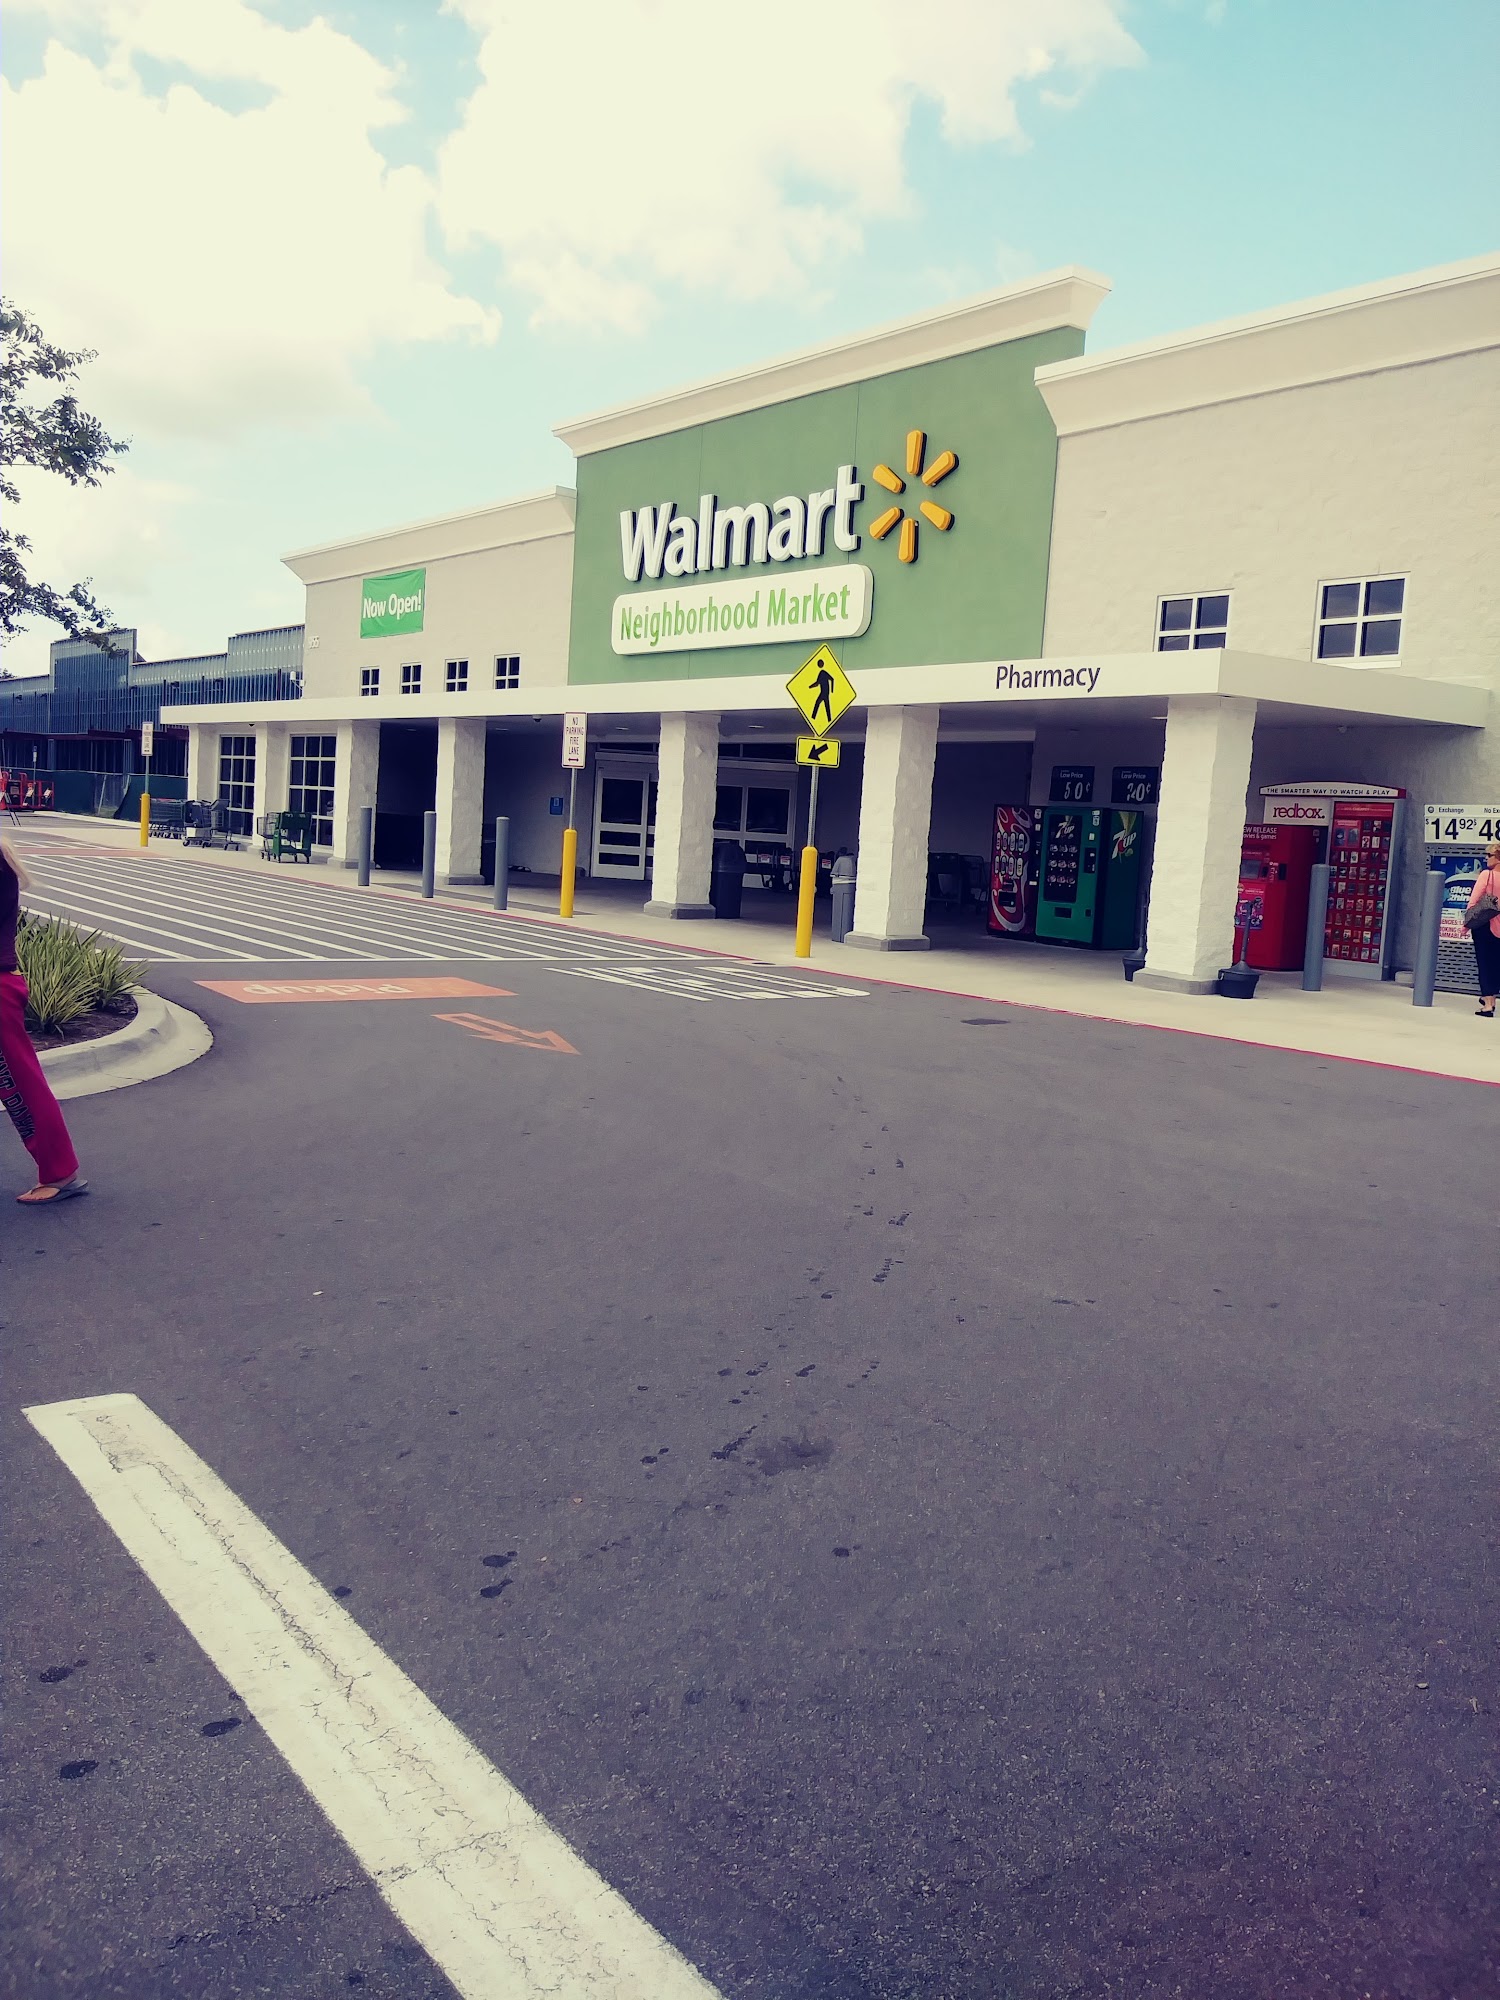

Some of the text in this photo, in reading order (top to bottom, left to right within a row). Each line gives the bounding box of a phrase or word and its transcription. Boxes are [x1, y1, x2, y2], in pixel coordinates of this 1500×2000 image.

[620, 465, 864, 582] Walmart
[363, 589, 422, 621] Now Open!
[620, 583, 850, 647] Neighborhood Market
[996, 664, 1101, 693] Pharmacy
[573, 717, 579, 725] NO
[566, 727, 584, 735] PARKING
[569, 746, 580, 755] LANE
[1133, 772, 1146, 780] Price
[1340, 788, 1364, 796] WATCH
[1438, 806, 1465, 815] Exchange
[1243, 826, 1278, 835] EW RELEASE
[1112, 830, 1137, 859] 7UP
[543, 966, 871, 1001] YIELD
[242, 983, 414, 996] Pickup
